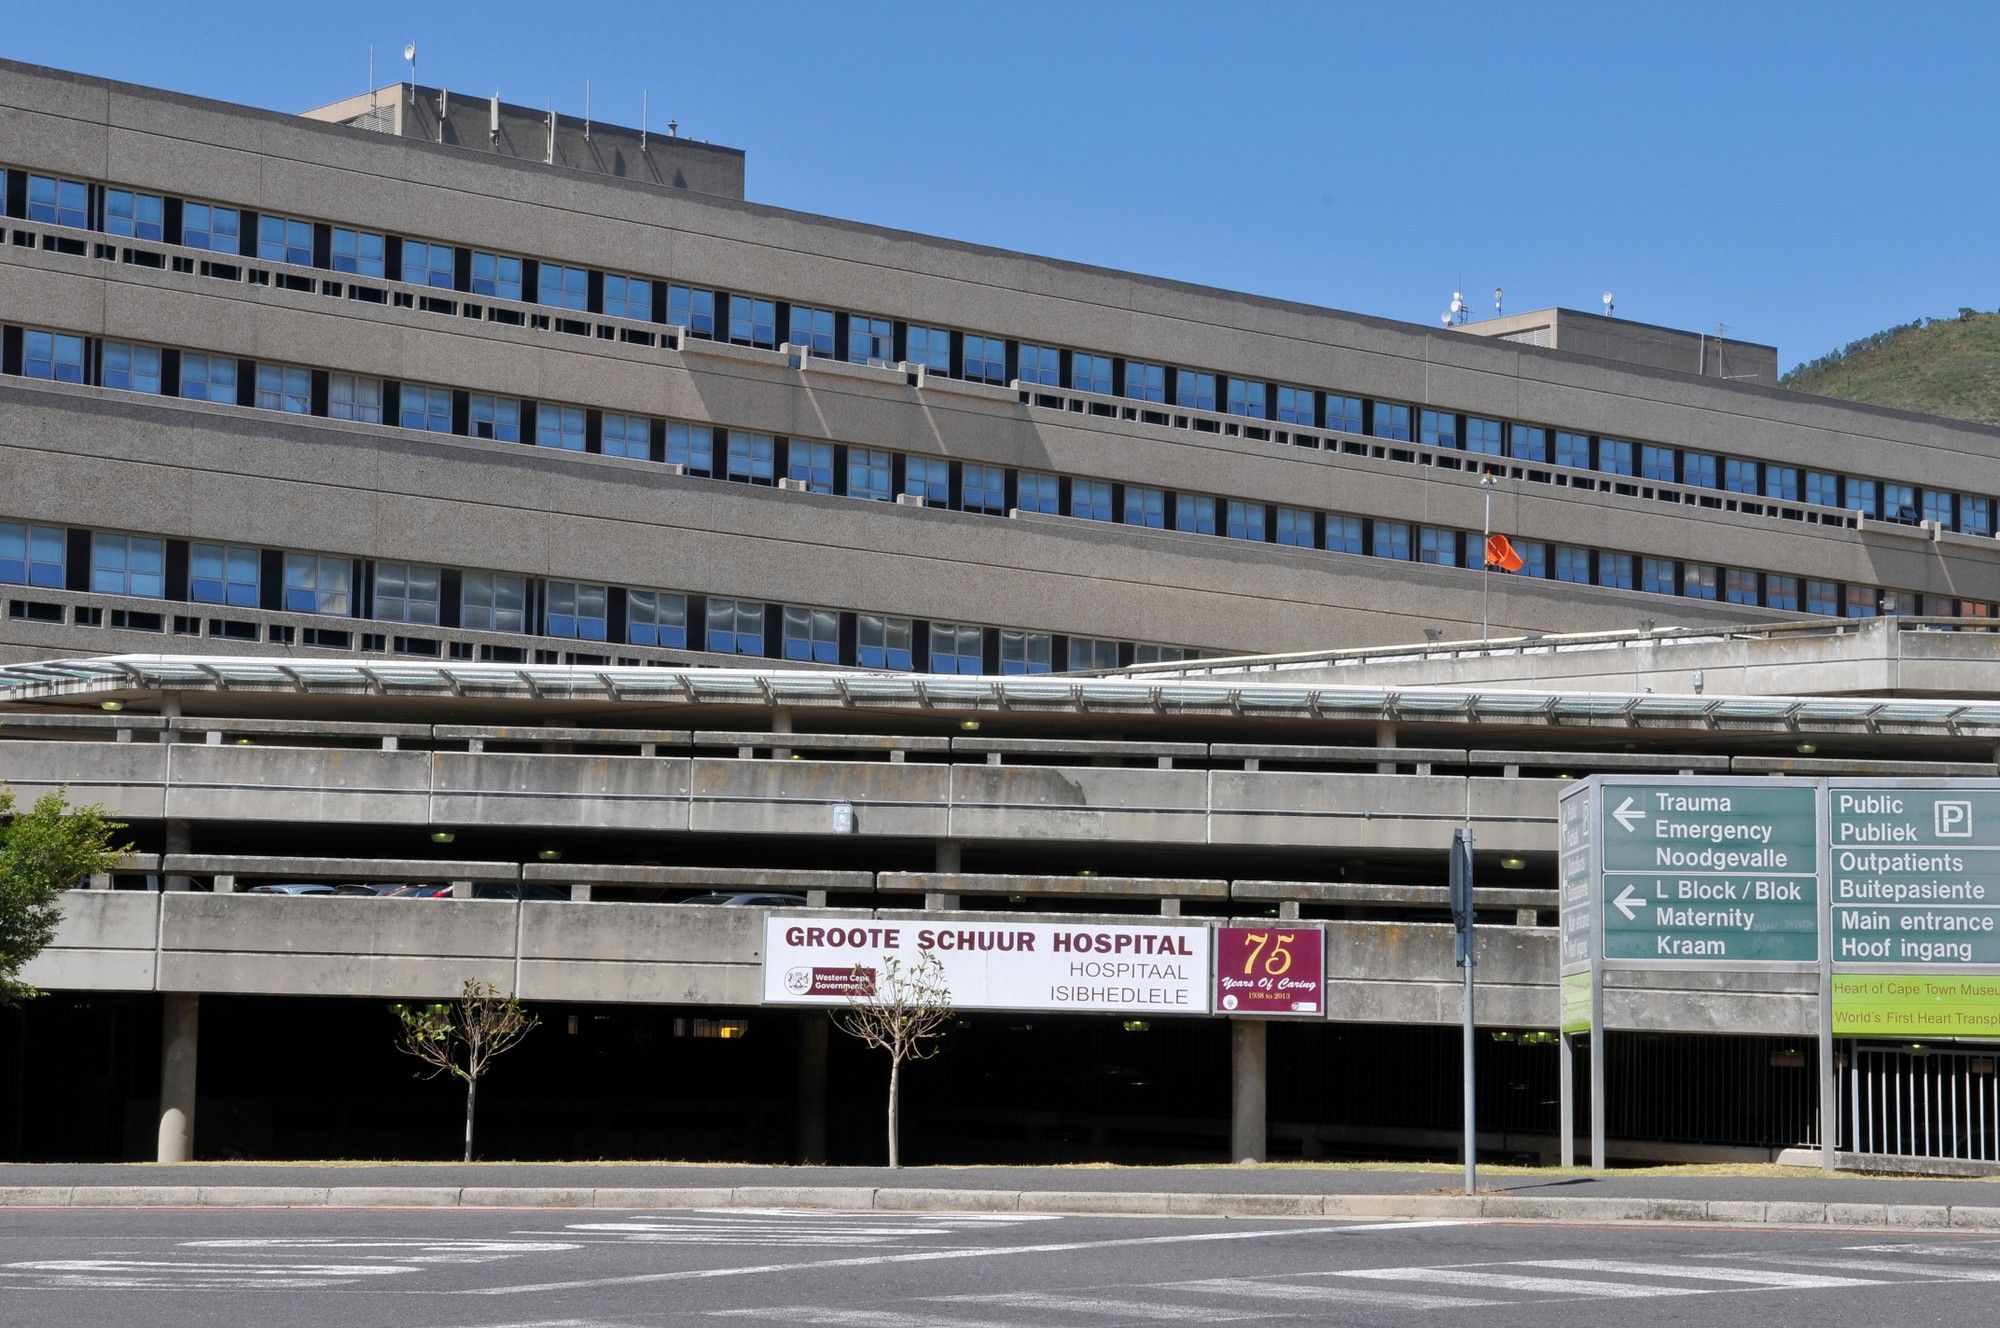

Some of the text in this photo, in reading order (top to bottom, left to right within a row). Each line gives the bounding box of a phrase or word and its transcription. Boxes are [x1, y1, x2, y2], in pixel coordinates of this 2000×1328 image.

[1656, 793, 1731, 811] Trauma
[1840, 795, 1904, 814] Public
[1656, 820, 1772, 843] Emergency
[1840, 822, 1918, 842] Publiek
[1656, 847, 1788, 870] Noodgevalle
[1839, 851, 1964, 875] Outpatients
[1656, 880, 1669, 899] L
[1678, 881, 1737, 899] Block
[1755, 882, 1802, 900] Blok
[1840, 879, 1985, 902] Buitepasiente
[1656, 907, 1755, 931] Maternity
[1841, 910, 1995, 932] Main entrance
[785, 926, 1193, 956] GROOTE SCHUUR HOSPITAL
[1657, 935, 1726, 955] Kraam
[1841, 937, 1973, 962] Hoof ingang
[1244, 932, 1295, 976] 75
[815, 974, 848, 982] Western
[1070, 961, 1189, 980] HOSPITAAL
[815, 982, 864, 990] Government
[1221, 976, 1317, 992] Years Of Caring
[1834, 982, 1867, 995] Heart
[1871, 982, 1884, 994] of
[1887, 983, 1920, 997] Cape
[1924, 983, 1957, 995] Town
[1051, 985, 1189, 1005] ISIBHEDLELE
[1248, 991, 1264, 999] 1938
[1273, 992, 1291, 1000] 2013
[1835, 1011, 1881, 1023] World's
[1886, 1012, 1913, 1024] First
[1917, 1012, 1952, 1024] Heart
